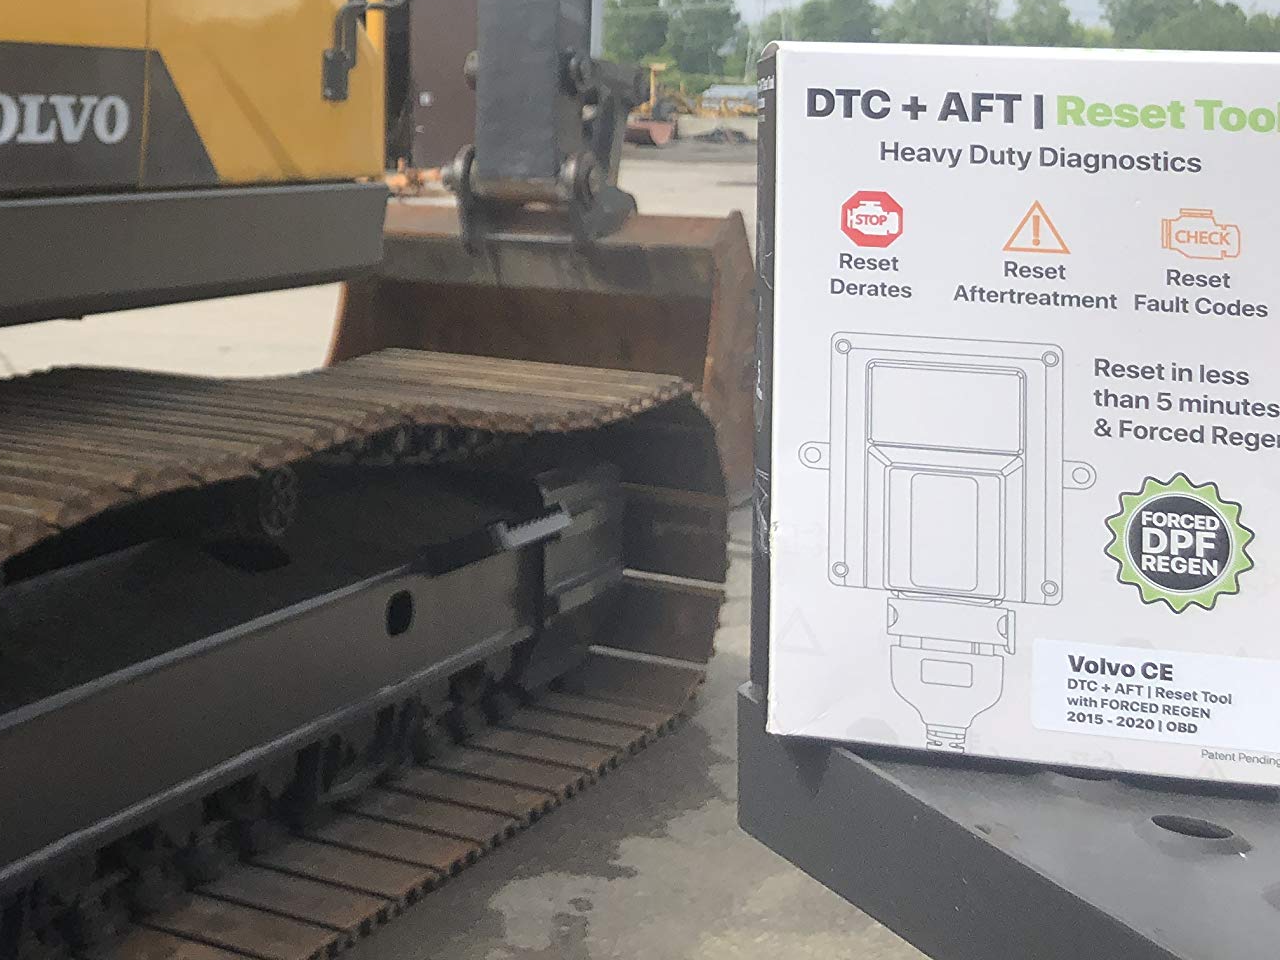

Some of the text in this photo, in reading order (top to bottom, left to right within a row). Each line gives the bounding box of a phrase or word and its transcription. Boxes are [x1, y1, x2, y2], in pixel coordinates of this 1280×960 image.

[806, 87, 891, 121] DTC
[901, 95, 928, 121] +
[937, 92, 1022, 124] AFT
[1056, 95, 1185, 130] Reset
[1194, 99, 1280, 133] Too
[879, 141, 1203, 174] Heavy Duty Diagnostics
[855, 214, 888, 227] STOP
[1175, 229, 1231, 246] CHECK
[839, 253, 900, 272] Reset
[1004, 261, 1067, 280] Reset
[830, 278, 913, 299] Derates
[1166, 269, 1231, 289] Reset
[953, 285, 1118, 310] Aftertreatment
[1134, 294, 1269, 318] Fault Codes
[1094, 358, 1250, 386] Reset in less
[1093, 389, 1280, 418] than 5 minutes
[1093, 418, 1280, 452] & Forced Rege
[1141, 510, 1220, 531] FORCED
[1141, 526, 1216, 558] DPF
[1141, 554, 1218, 577] REGEN
[1067, 654, 1174, 682] Volvo CE
[1067, 678, 1098, 692] DTC
[1114, 682, 1144, 697] AFT
[1155, 686, 1198, 702] Reset
[1201, 690, 1233, 705] Tool
[1066, 695, 1211, 719] with FORCED REGEN
[1066, 711, 1104, 725] 2015
[1116, 716, 1155, 730] 2020
[1166, 721, 1198, 734] OBD
[1201, 748, 1236, 762] Patent
